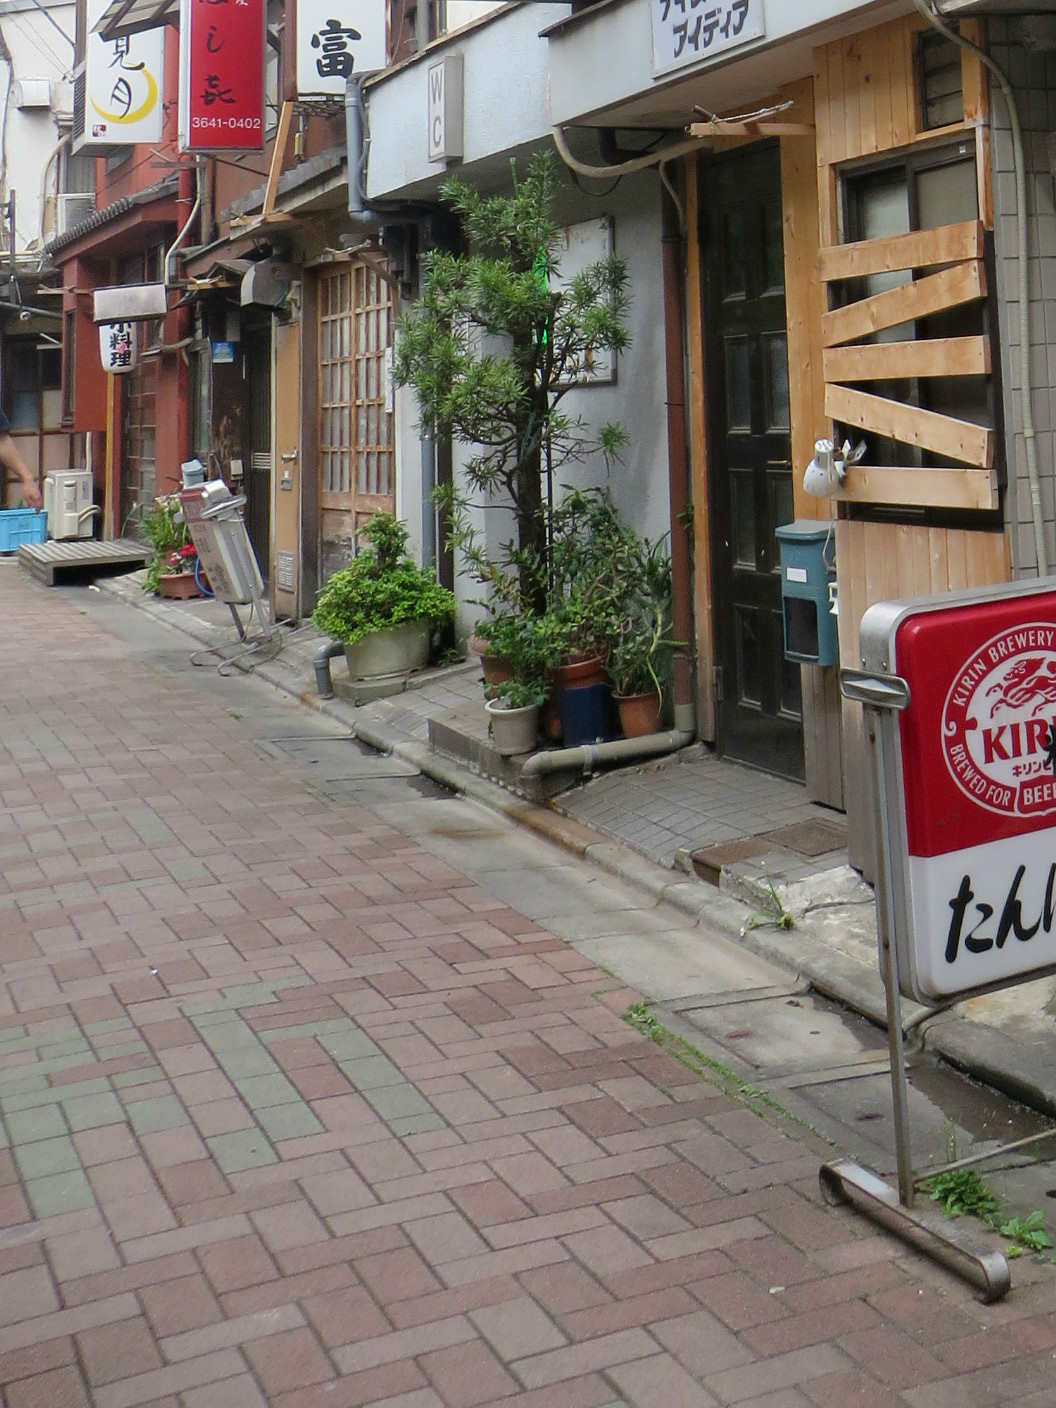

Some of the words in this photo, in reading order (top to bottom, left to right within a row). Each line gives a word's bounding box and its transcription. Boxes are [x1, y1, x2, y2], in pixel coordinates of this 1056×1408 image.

[192, 116, 261, 130] 3641-0402
[431, 69, 443, 148] WC
[953, 658, 987, 707] KIRIN
[988, 630, 1055, 663] BREWERY
[950, 743, 983, 795] BREWED
[985, 785, 1012, 807] FOR
